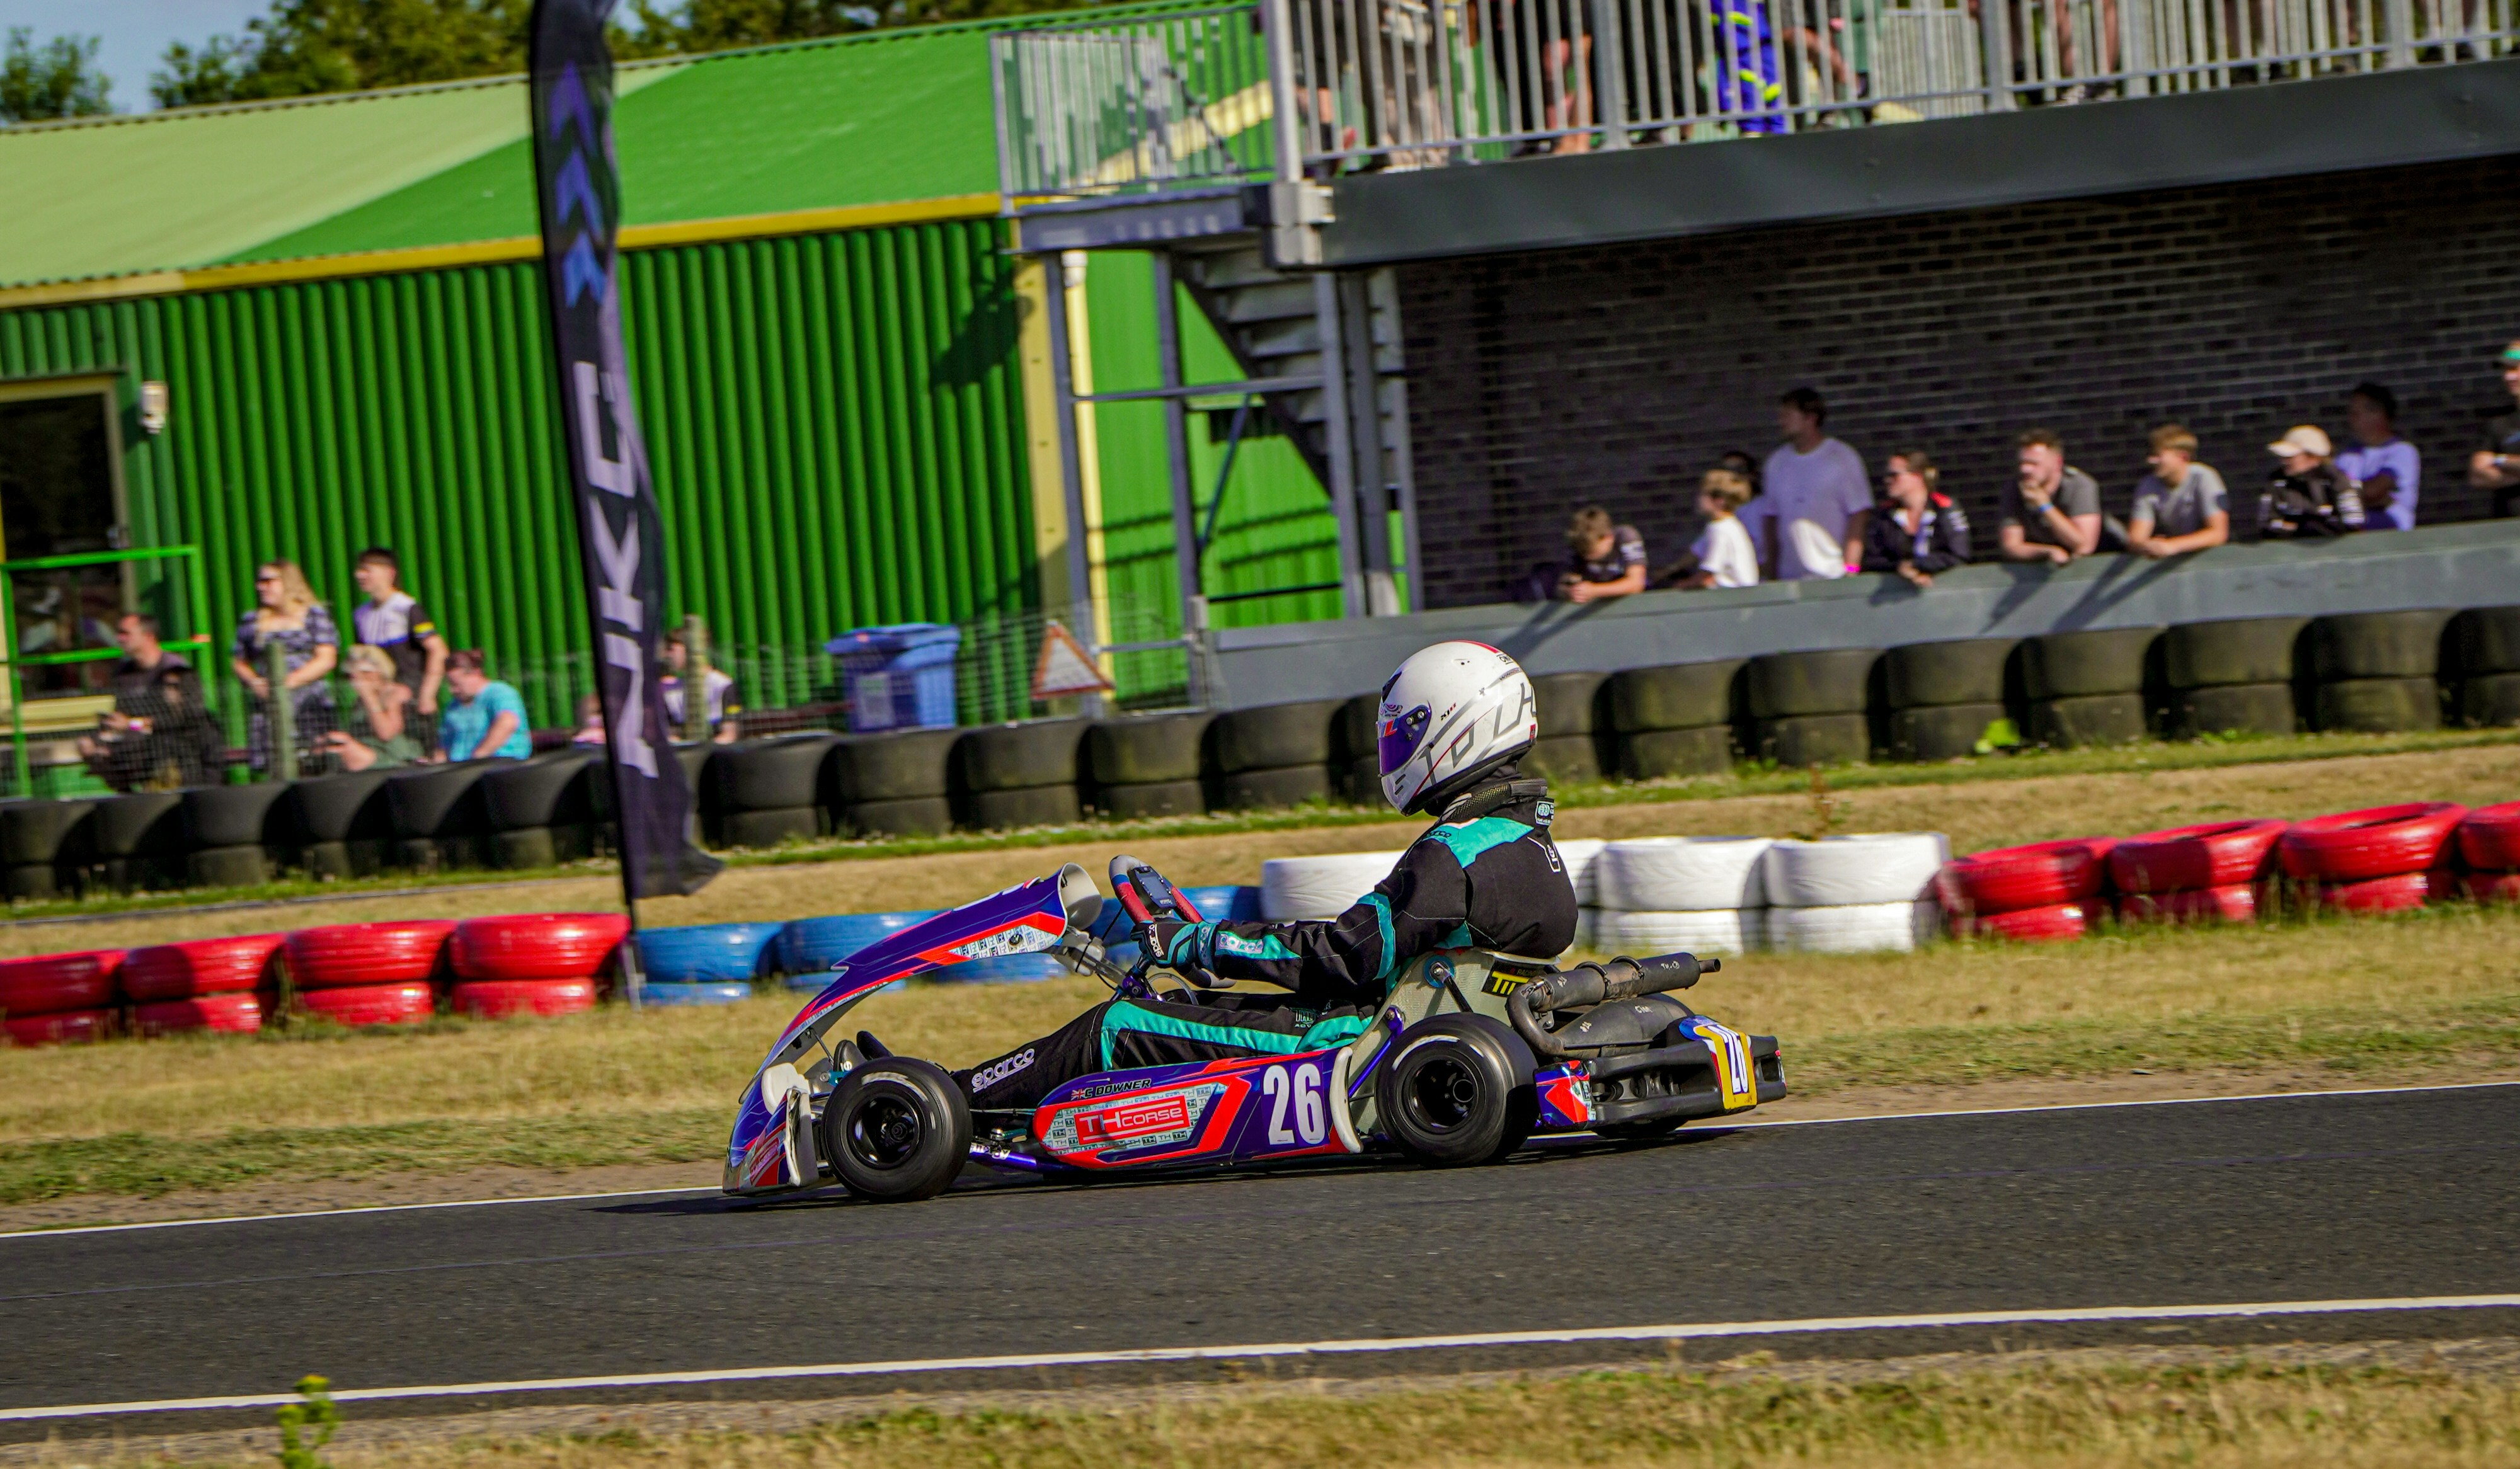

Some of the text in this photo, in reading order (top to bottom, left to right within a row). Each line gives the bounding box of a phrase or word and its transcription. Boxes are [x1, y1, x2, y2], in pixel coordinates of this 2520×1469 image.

[971, 1048, 1034, 1093] sparco
[1084, 1078, 1152, 1099] C DOWNER
[1263, 1063, 1326, 1145] 26
